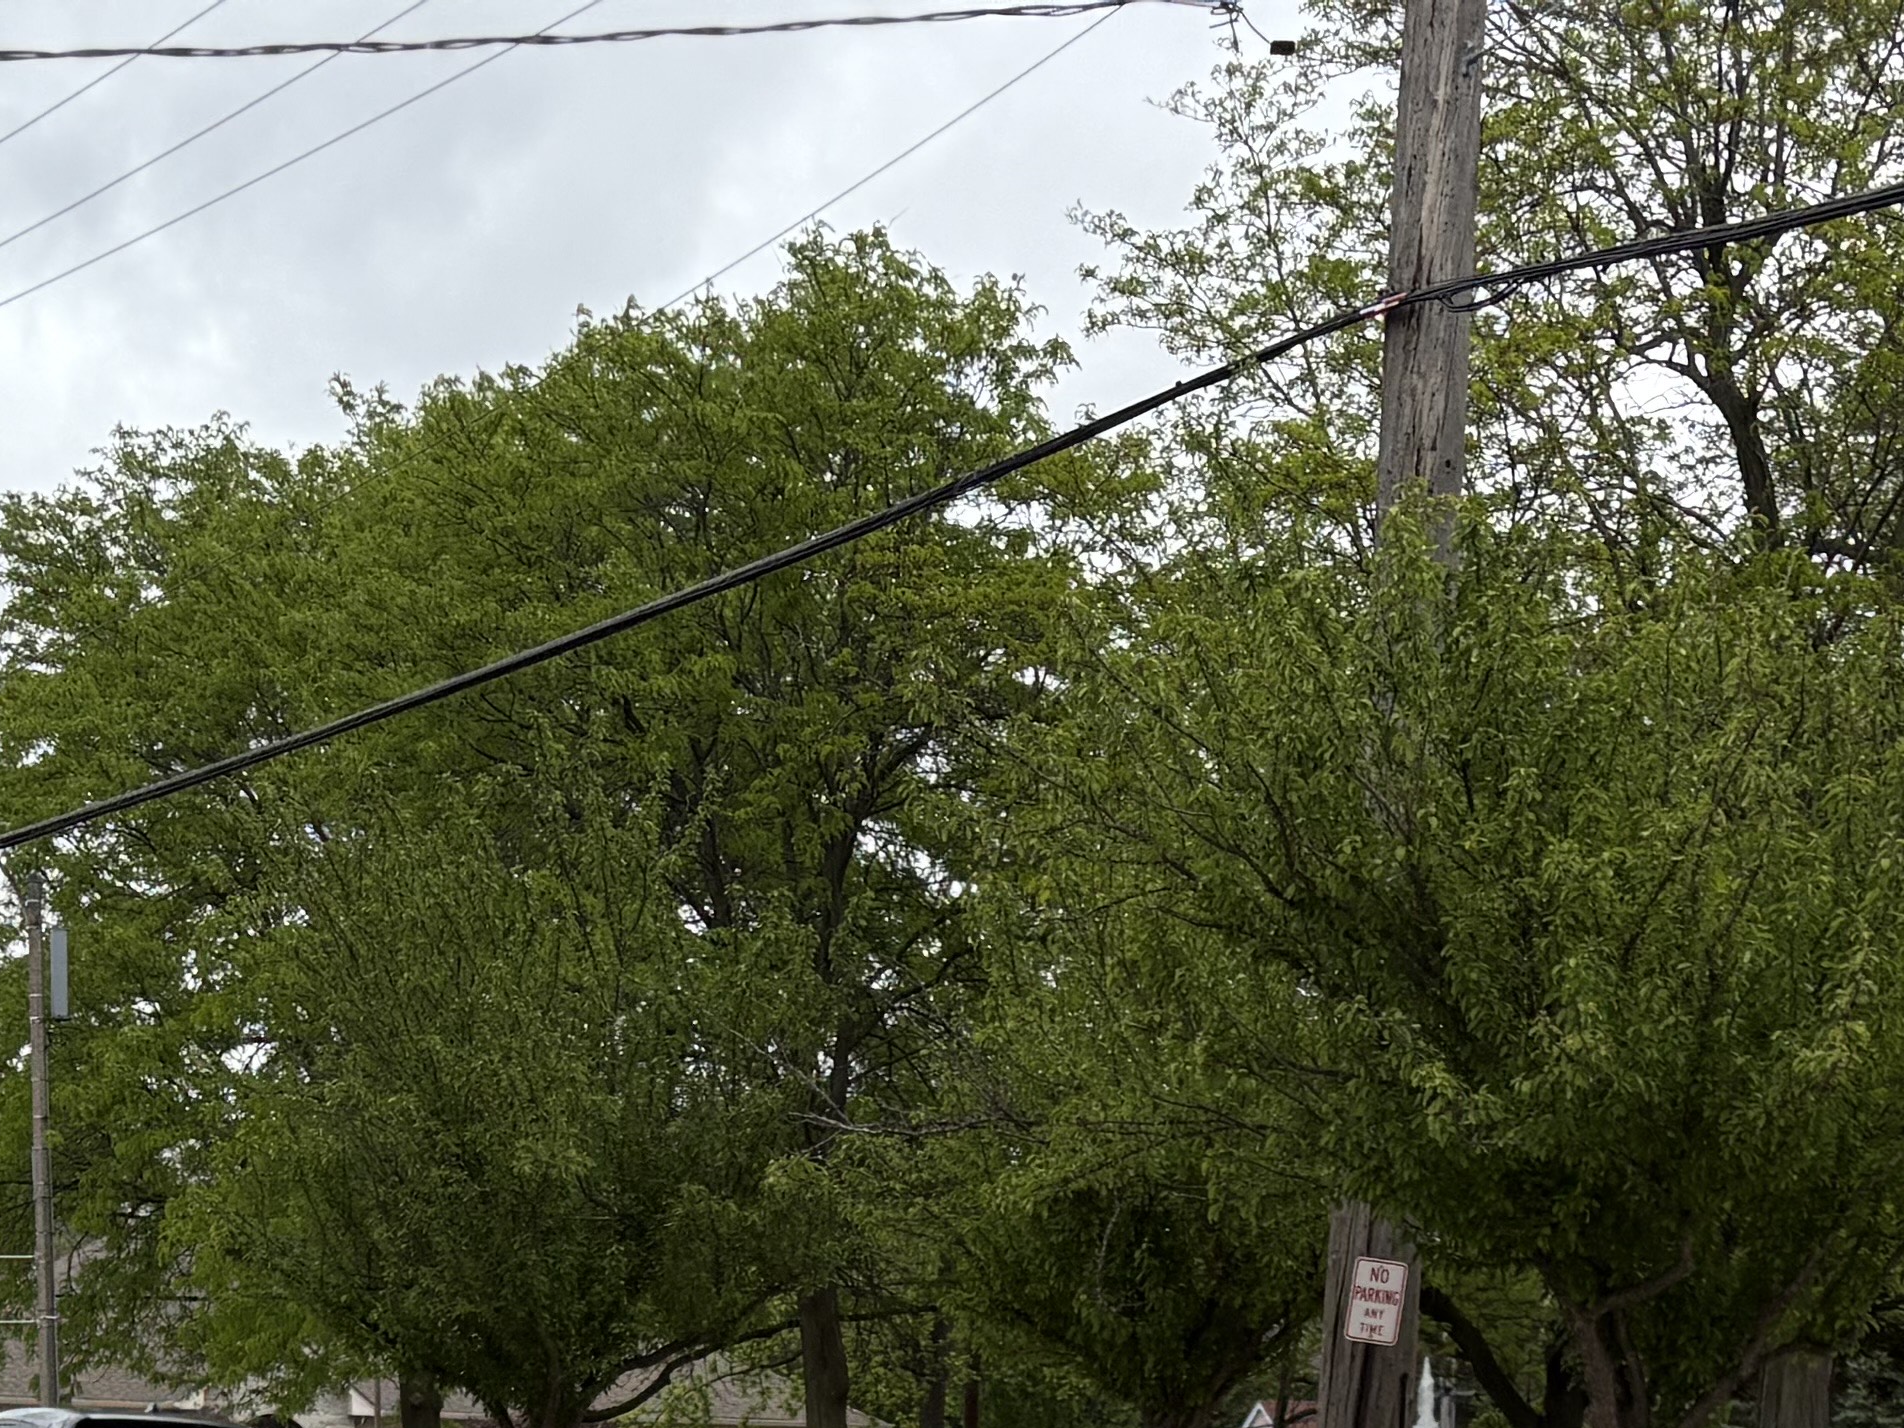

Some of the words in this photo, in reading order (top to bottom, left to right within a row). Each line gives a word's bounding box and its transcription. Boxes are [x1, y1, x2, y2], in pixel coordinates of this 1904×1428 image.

[1370, 1268, 1389, 1283] NO
[1353, 1285, 1399, 1306] PARKING
[1364, 1308, 1384, 1320] ANY
[1360, 1323, 1384, 1336] TIME
